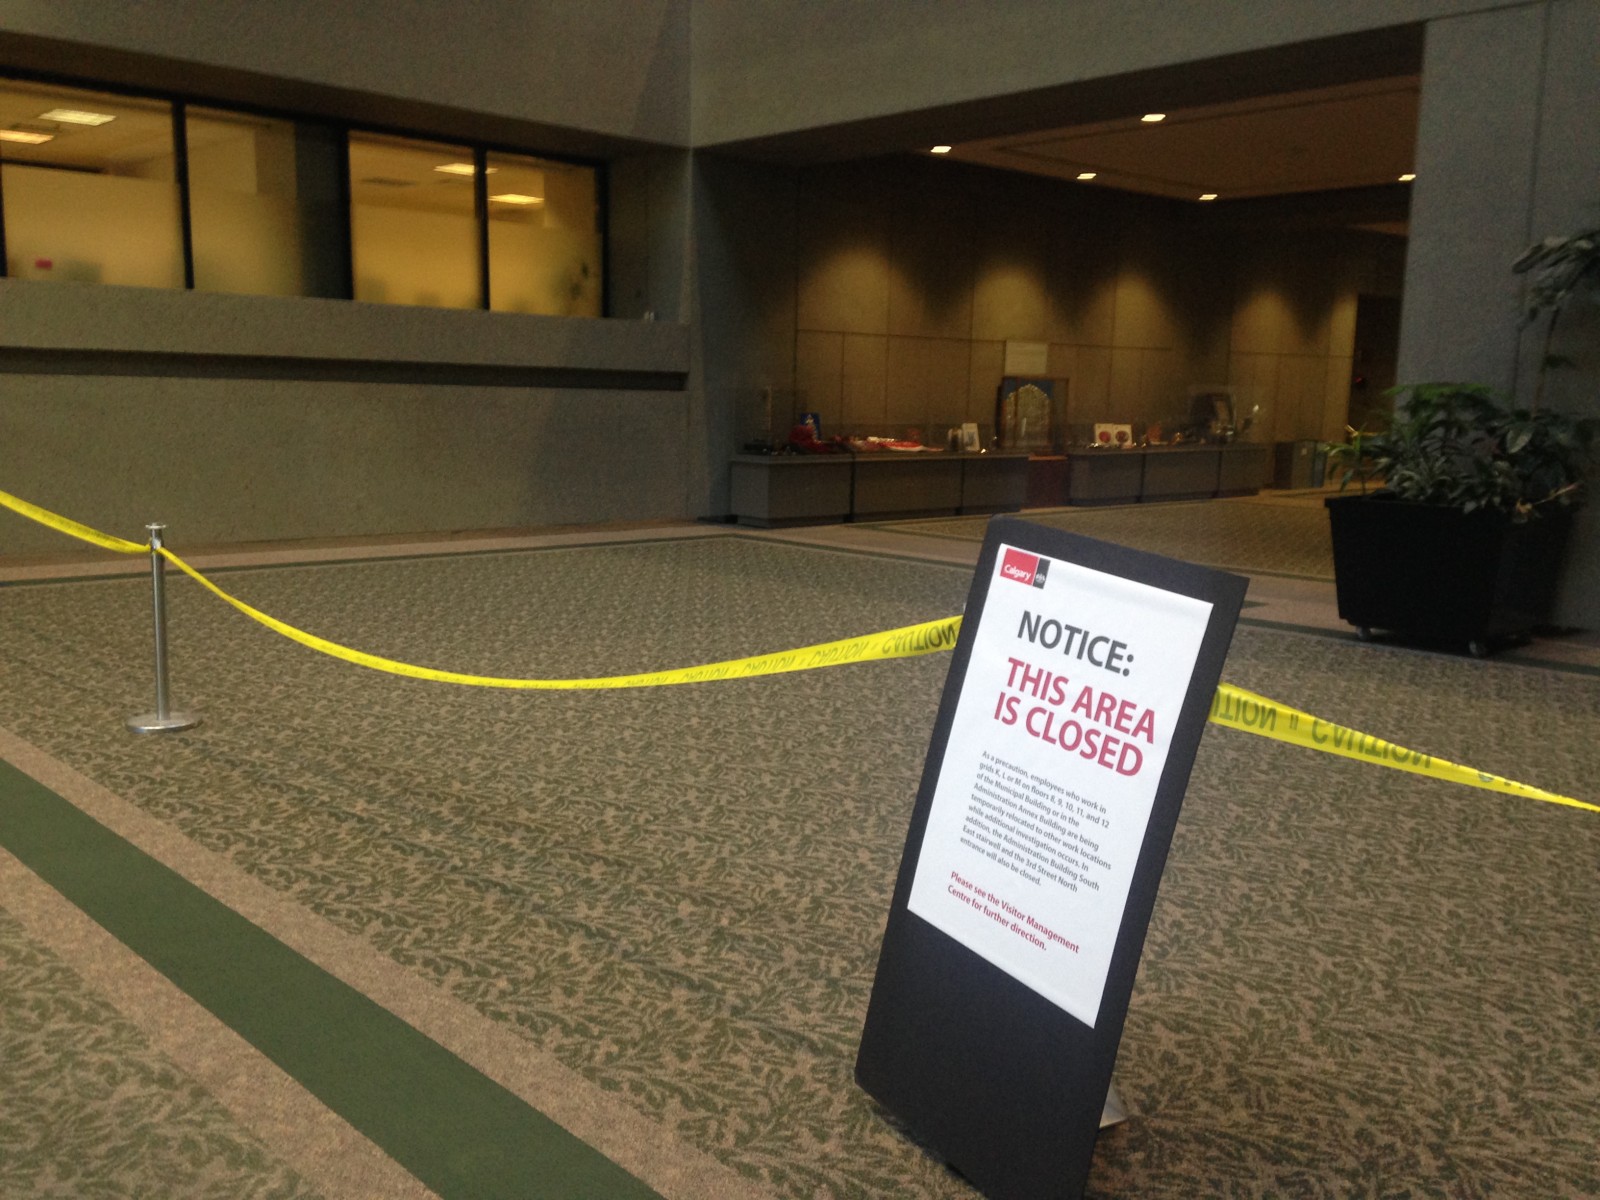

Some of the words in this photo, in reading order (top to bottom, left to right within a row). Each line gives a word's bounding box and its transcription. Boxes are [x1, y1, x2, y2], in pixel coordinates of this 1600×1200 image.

[1004, 564, 1031, 581] Calgary
[1017, 610, 1134, 677] NOTICE:
[993, 691, 1022, 726] IS
[1025, 706, 1144, 777] CLOSED
[1007, 656, 1070, 706] THIS
[1070, 685, 1155, 745] AREA
[978, 762, 995, 774] grids
[1030, 784, 1050, 801] floors
[994, 757, 1029, 779] precaution,
[1030, 774, 1065, 795] employees
[1080, 797, 1099, 811] work
[994, 779, 1025, 801] Municipal
[1024, 794, 1052, 816] Building
[968, 805, 985, 818] while
[984, 813, 1016, 834] additional
[1015, 827, 1057, 856] investigation
[1056, 851, 1081, 868] occurs.
[970, 793, 1006, 817] temporarily
[1005, 811, 1036, 832] relocated
[1043, 831, 1062, 845] other
[1062, 840, 1079, 854] work
[1079, 847, 1112, 871] locations
[973, 782, 1018, 810] Administration
[1017, 804, 1039, 820] Annex
[1038, 814, 1067, 836] Building
[1078, 833, 1100, 853] being
[959, 836, 986, 855] entrance
[985, 850, 998, 861] will
[996, 857, 1011, 869] also
[1019, 869, 1041, 886] closed.
[962, 824, 976, 837] East
[975, 832, 1002, 851] stairwell
[1036, 864, 1058, 882] Street
[1057, 875, 1078, 893] North
[965, 815, 991, 834] addition,
[1002, 833, 1050, 865] Administration
[1049, 858, 1079, 882] Building
[1078, 873, 1100, 892] South
[947, 884, 971, 905] Centre
[983, 905, 1010, 928] further
[1009, 922, 1047, 951] direction.
[950, 870, 974, 891] Please
[1001, 899, 1026, 922] Visitor
[1026, 915, 1080, 954] Management
